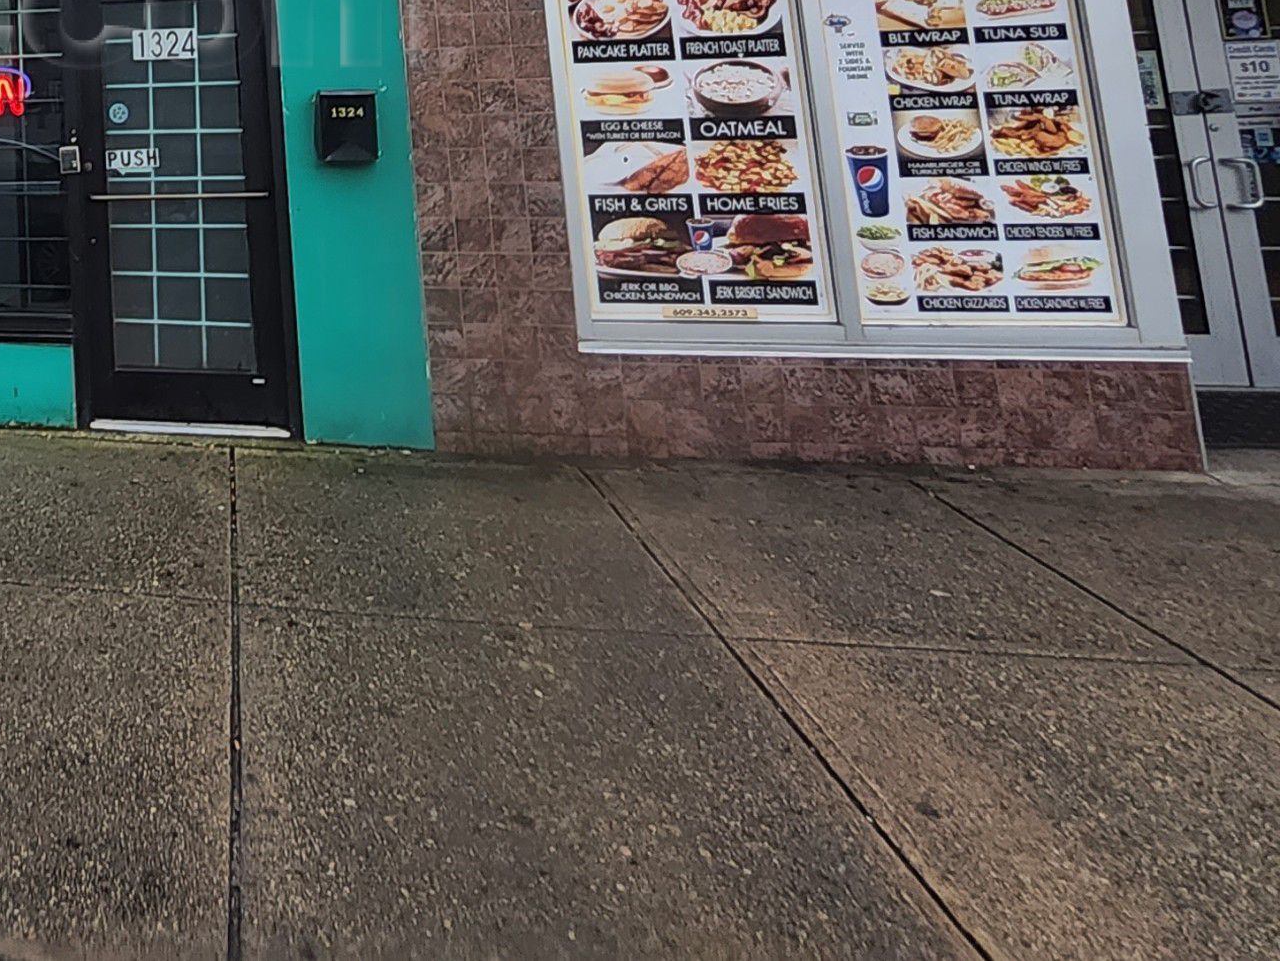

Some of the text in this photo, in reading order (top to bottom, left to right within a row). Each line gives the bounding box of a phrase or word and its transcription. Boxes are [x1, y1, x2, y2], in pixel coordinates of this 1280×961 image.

[888, 30, 962, 44] BLT WRAP
[982, 26, 1059, 41] TUNA SUB
[136, 30, 195, 58] 1324
[577, 42, 670, 59] PANCAKE PLATTER
[686, 38, 780, 56] FRENCH TOAST PLATTER
[1240, 60, 1270, 72] $10
[893, 94, 973, 109] CHICKEN WRAP
[993, 92, 1069, 105] TUNA WRAP
[331, 106, 364, 119] 1324
[601, 121, 663, 132] EGG & CHEESE
[700, 120, 787, 137] OATMEAL
[630, 131, 639, 140] OR
[656, 130, 681, 139] BACON
[108, 149, 158, 168] PUSH
[907, 161, 964, 169] HAMBURGER
[997, 161, 1027, 172] CHICKEN
[1027, 160, 1052, 172] WINGS
[594, 196, 688, 212] FISH & GRITS
[706, 196, 799, 211] HOME FRIES
[912, 226, 997, 239] FISH SANDWICH
[620, 282, 679, 293] JERK OR BBQ
[715, 285, 813, 300] JERK BRISKET SANDWICH
[603, 290, 701, 301] CHICKEN SANDWICH
[922, 297, 1007, 309] CHICKEN GIZZARDS
